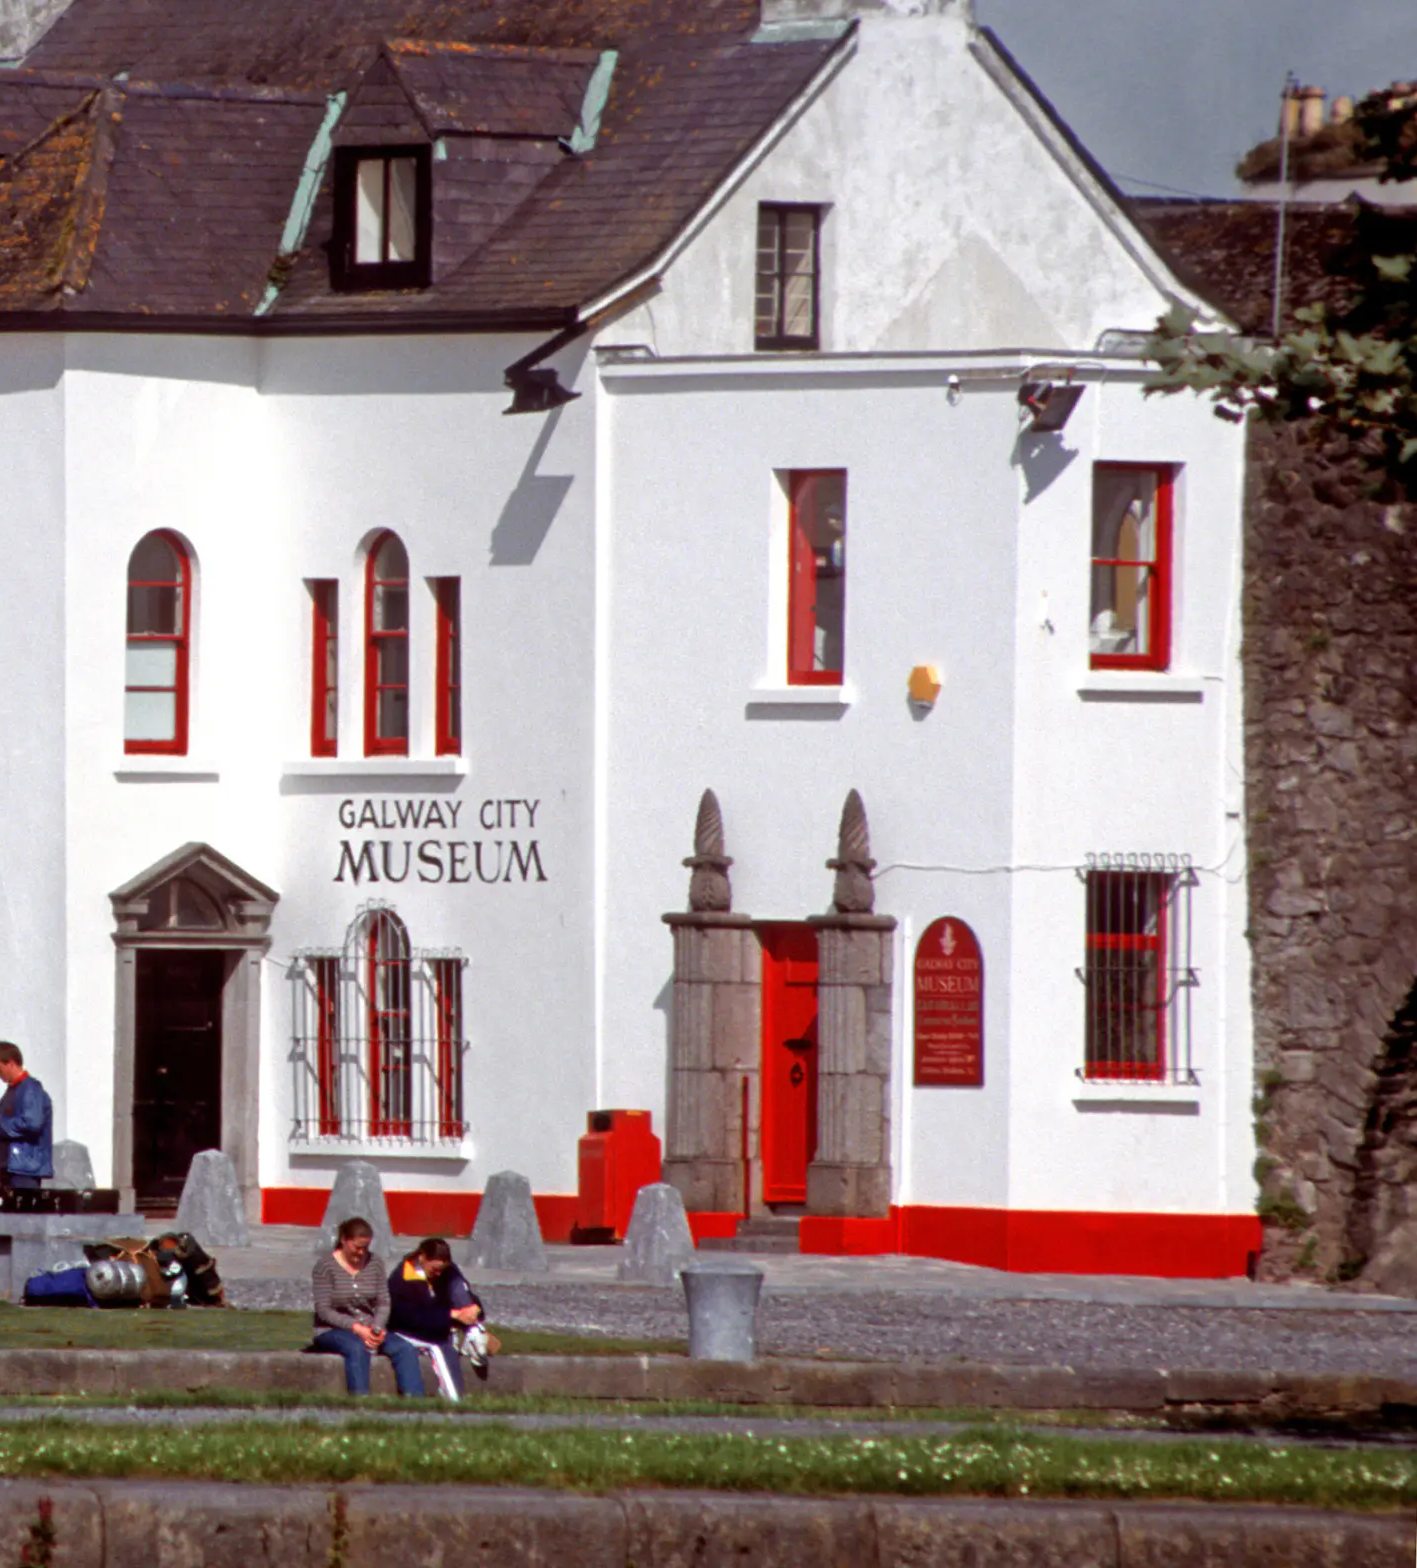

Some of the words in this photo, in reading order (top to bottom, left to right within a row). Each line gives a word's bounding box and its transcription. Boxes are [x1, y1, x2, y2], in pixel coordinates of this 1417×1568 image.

[338, 799, 463, 829] GALWAY
[479, 799, 540, 830] CITY
[333, 840, 548, 885] MUSEUM
[917, 976, 979, 993] MUSEUM
